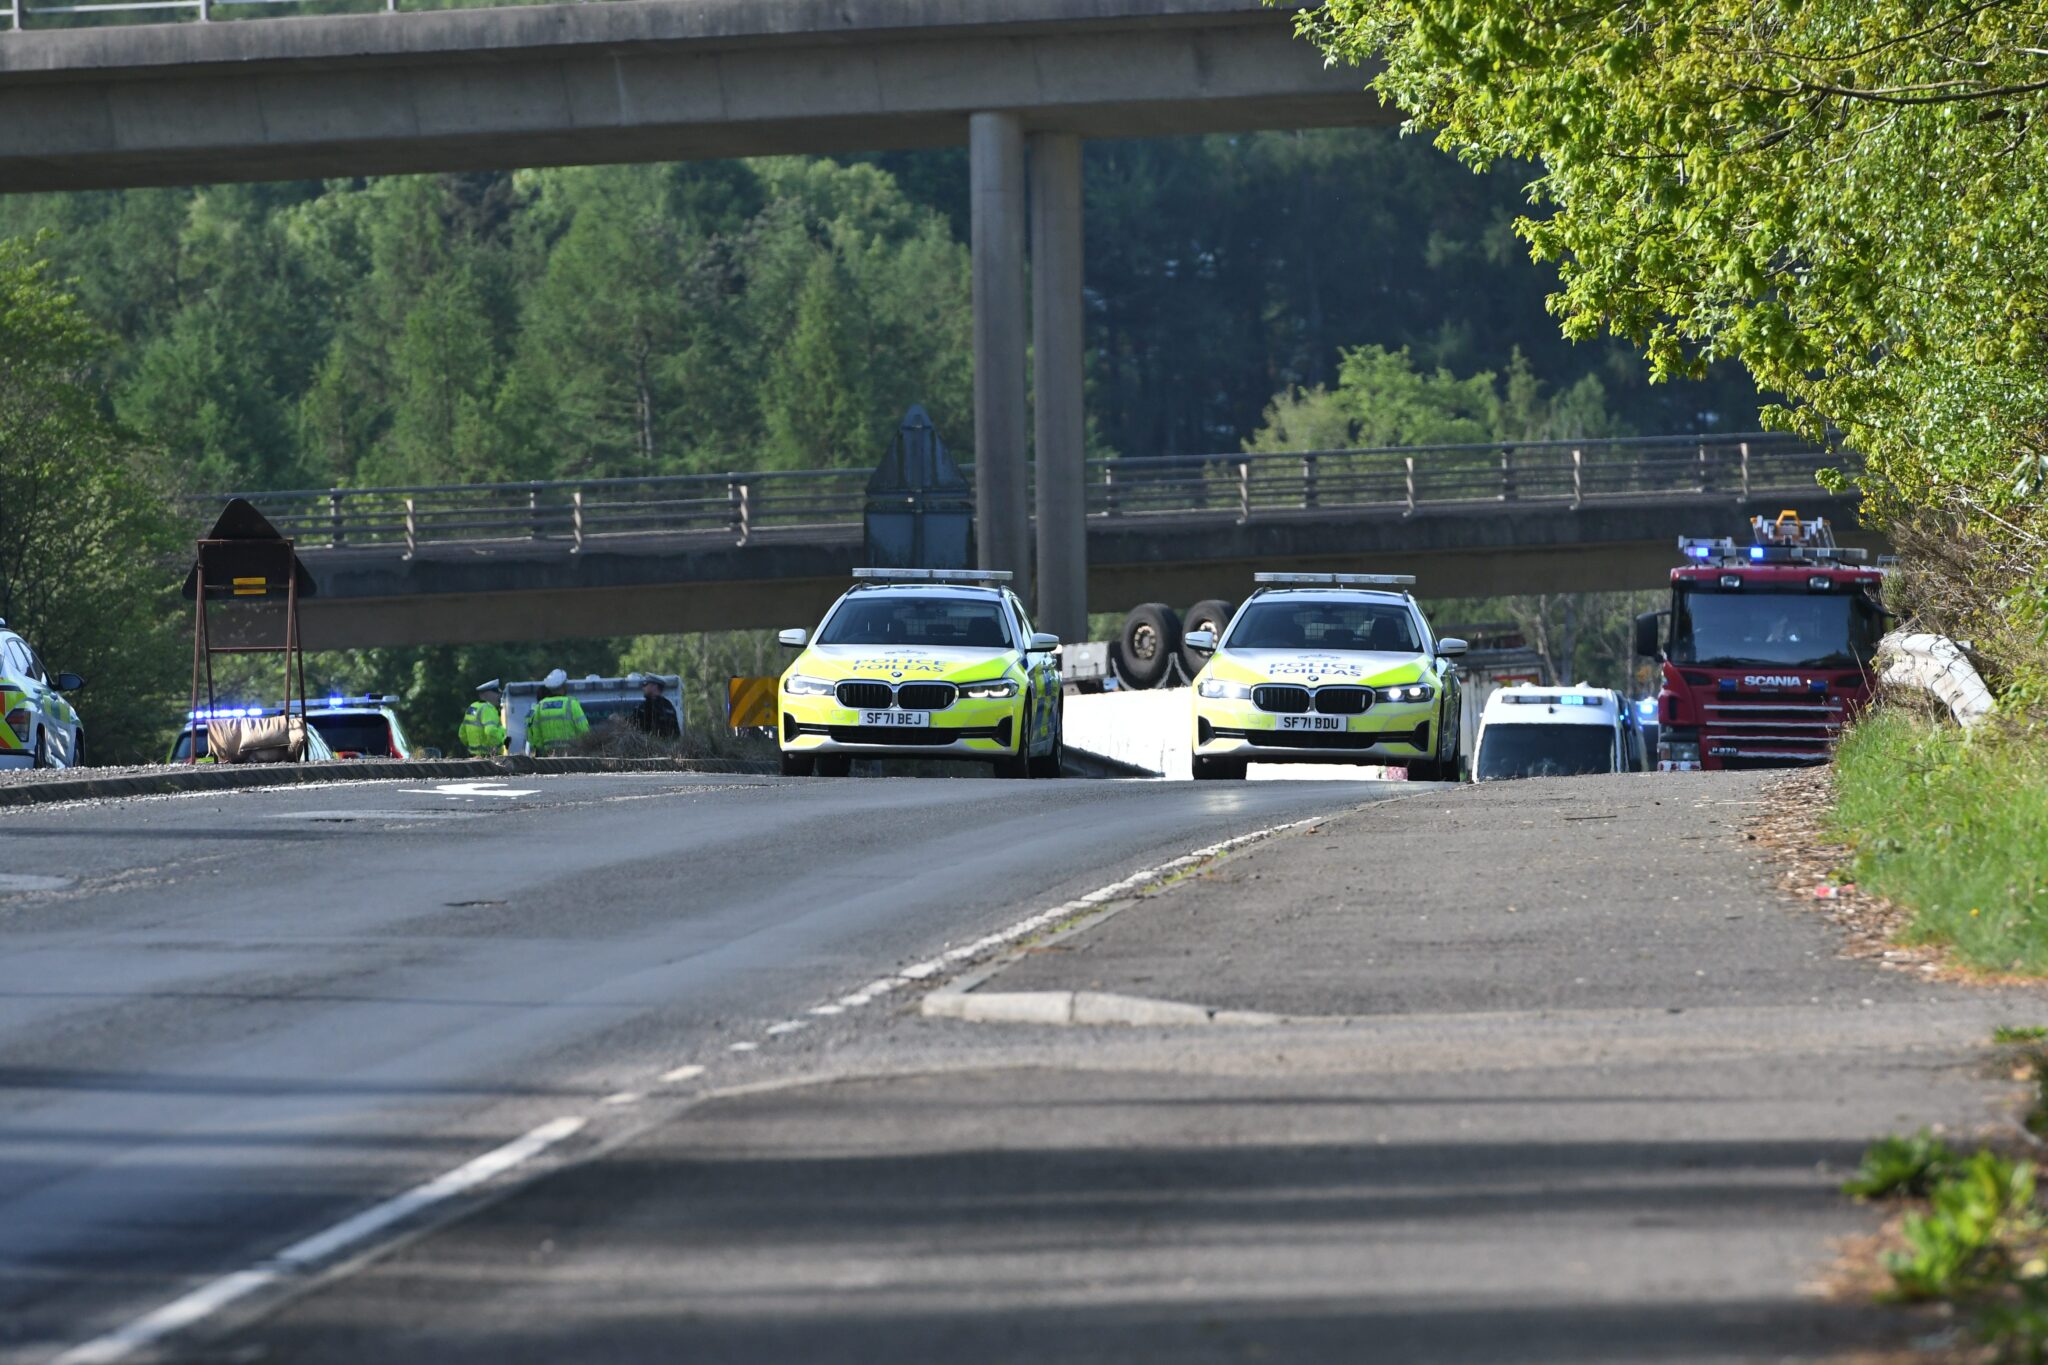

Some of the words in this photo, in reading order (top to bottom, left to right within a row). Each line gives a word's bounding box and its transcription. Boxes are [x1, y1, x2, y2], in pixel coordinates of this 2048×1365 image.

[855, 658, 946, 667] POLICE
[1269, 662, 1363, 671] POLICE
[853, 664, 944, 673] POILEAS
[1268, 668, 1362, 677] POILEAS
[1744, 675, 1801, 687] SCANIA
[867, 712, 894, 725] SF71
[897, 713, 922, 725] BEJ
[1283, 716, 1311, 729] SF71
[1315, 717, 1339, 730] BDU
